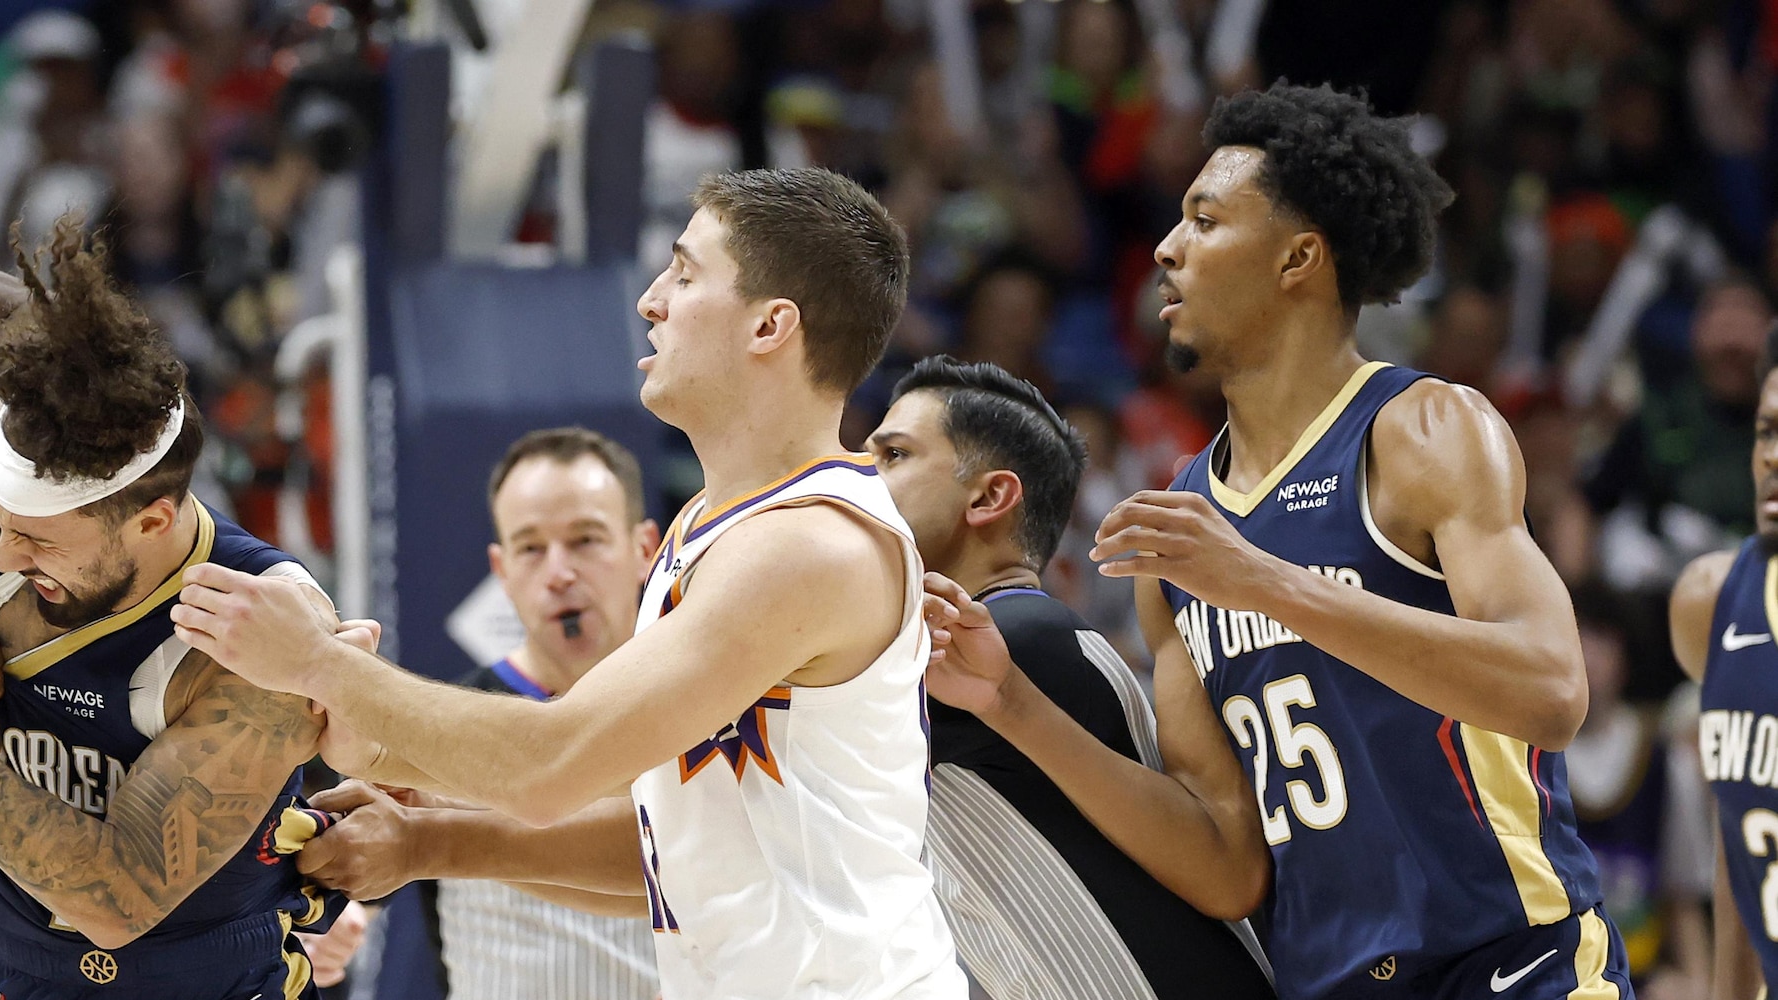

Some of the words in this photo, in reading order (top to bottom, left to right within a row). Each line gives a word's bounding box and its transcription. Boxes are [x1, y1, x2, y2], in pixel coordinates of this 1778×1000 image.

[1277, 475, 1338, 502] NEWAGE
[1286, 496, 1328, 512] GARAGE
[33, 683, 105, 709] NEWAGE
[65, 706, 95, 718] AGE
[1222, 674, 1348, 846] 25
